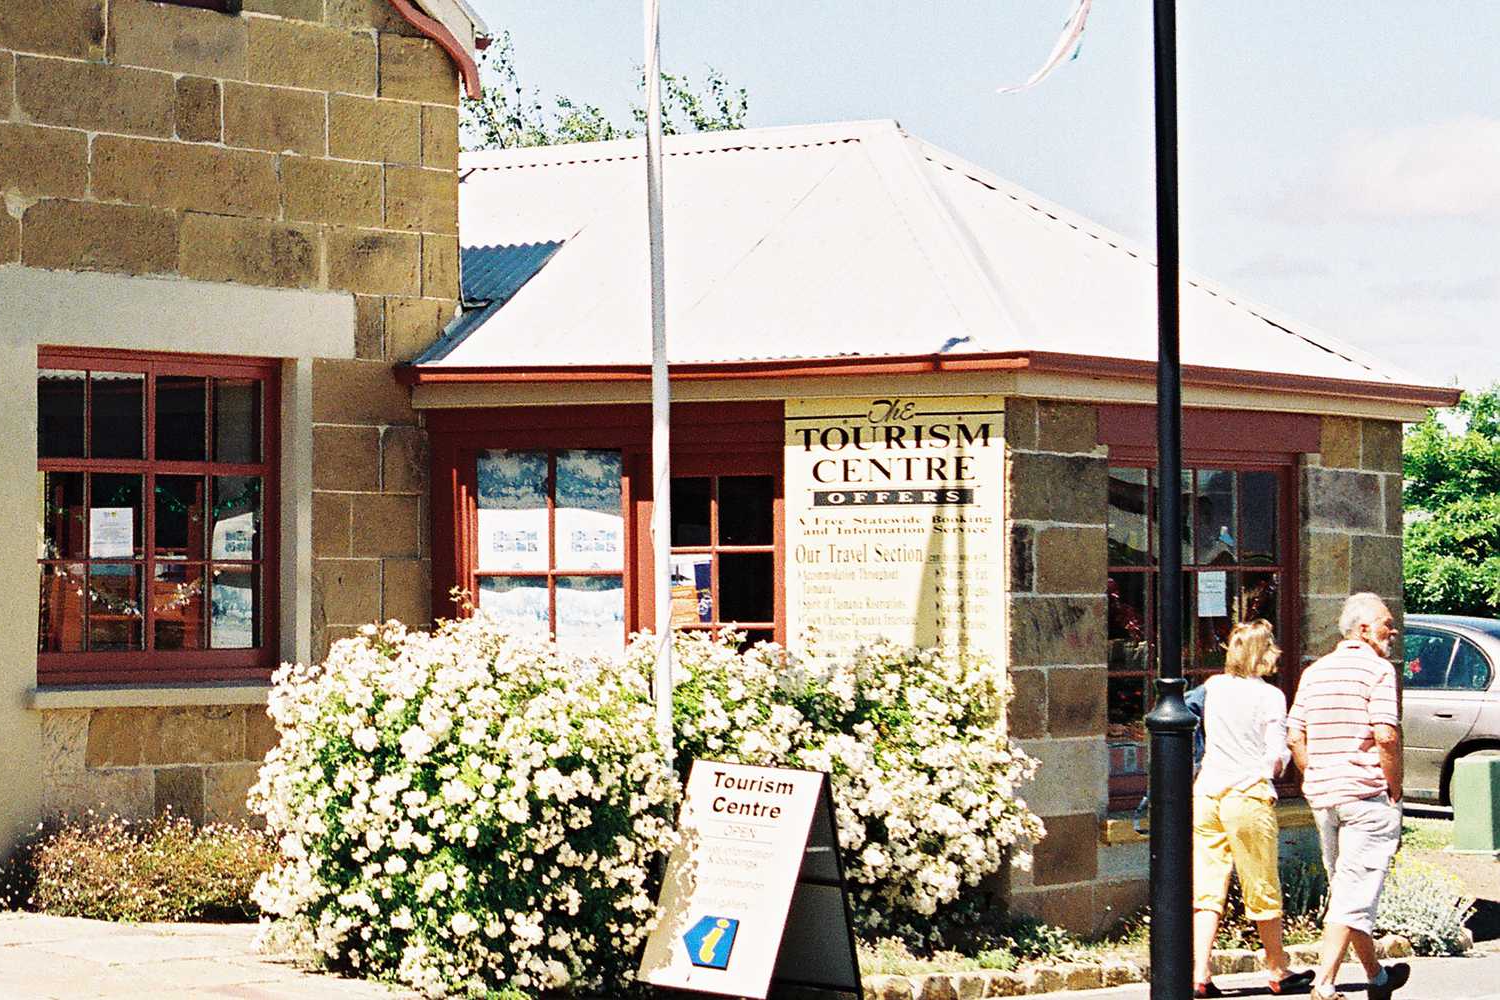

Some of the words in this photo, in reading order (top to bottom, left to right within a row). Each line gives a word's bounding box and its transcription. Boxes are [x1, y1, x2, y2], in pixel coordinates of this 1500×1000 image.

[867, 399, 915, 423] The
[795, 424, 991, 452] TOURISM
[812, 456, 975, 483] CENTRE
[827, 490, 960, 504] OFFERS
[798, 517, 806, 525] A
[814, 517, 844, 526] Free
[853, 516, 922, 525] Statewide
[932, 514, 993, 524] Booking
[803, 526, 829, 536] and
[837, 526, 925, 536] Information
[933, 524, 987, 534] Service
[795, 543, 821, 564] Our
[827, 543, 868, 563] Travel
[874, 542, 924, 563] Section
[714, 771, 794, 796] Tourism
[712, 796, 781, 819] Centre
[723, 824, 756, 839] OPEN
